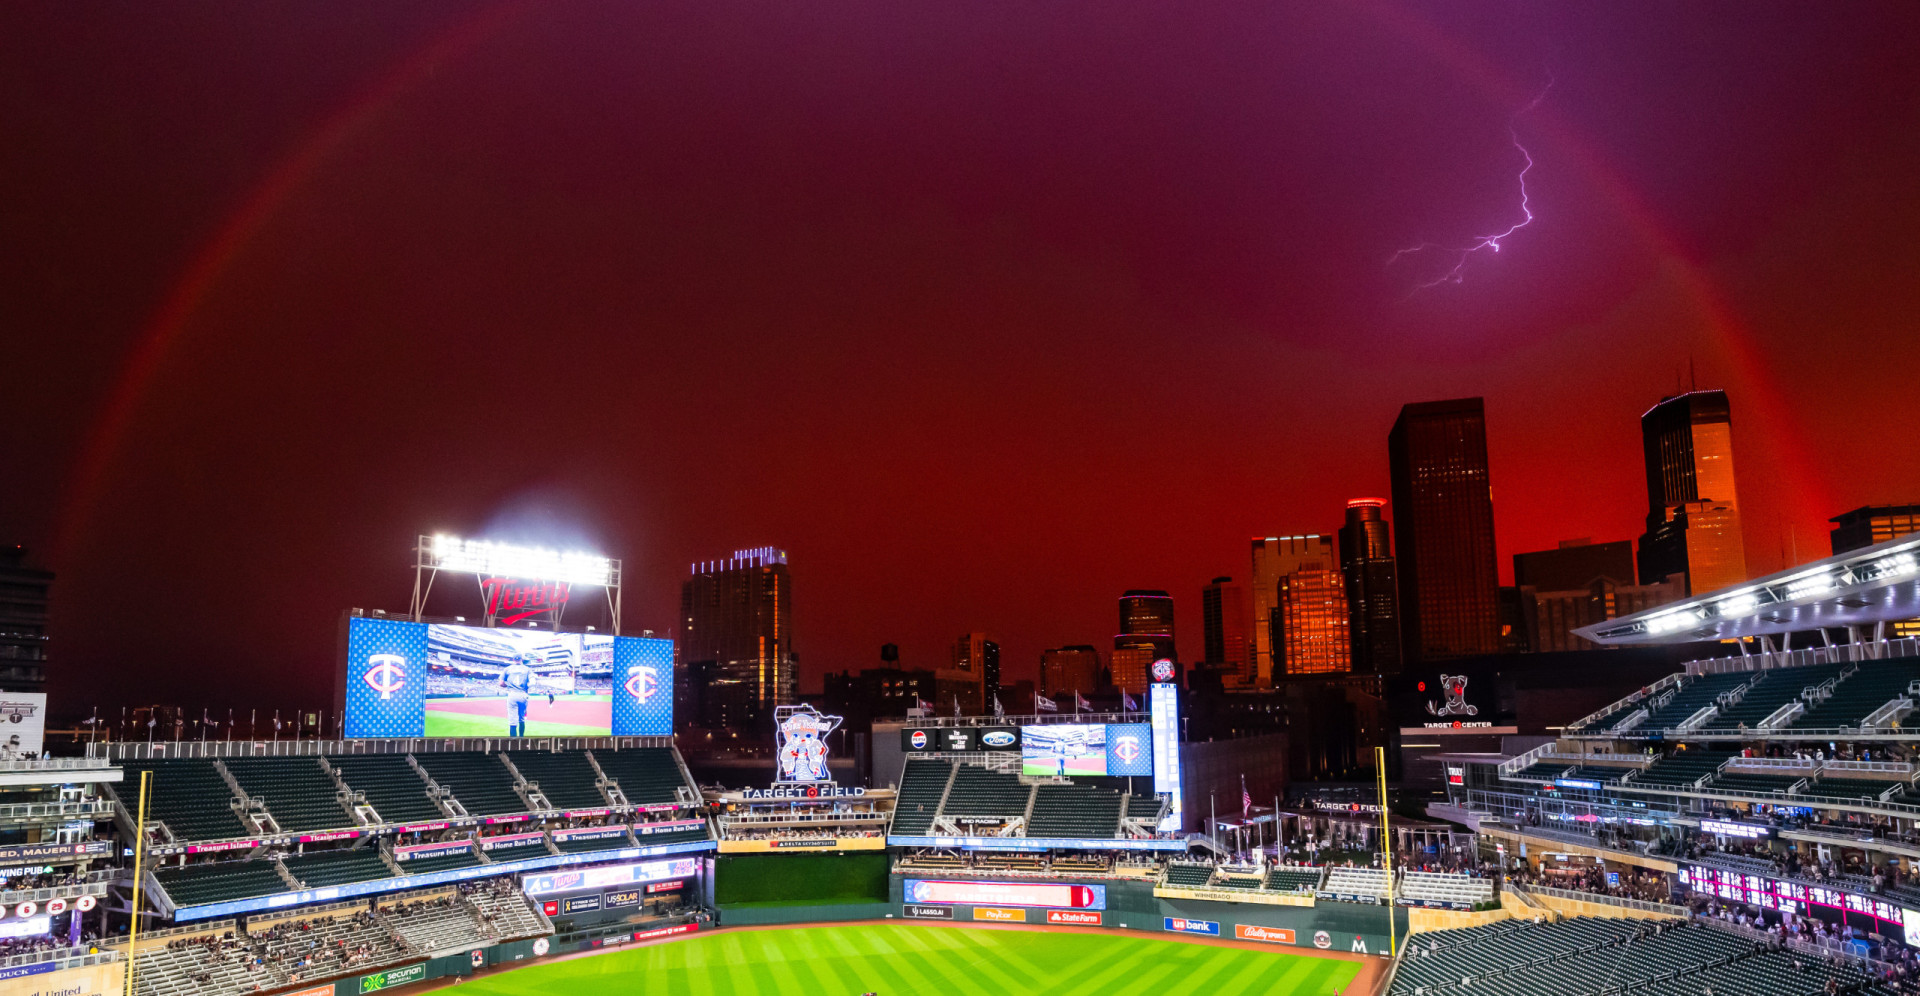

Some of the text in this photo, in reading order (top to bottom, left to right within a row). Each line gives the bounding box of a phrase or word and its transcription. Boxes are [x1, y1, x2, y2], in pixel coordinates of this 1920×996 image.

[482, 577, 569, 615] Twins
[988, 736, 1009, 744] Ford
[744, 787, 865, 798] TARGET FIELD
[23, 846, 71, 856] MAUER!
[196, 844, 229, 852] Treasure
[414, 851, 445, 859] Treasure
[24, 866, 43, 875] PUB
[552, 873, 580, 889] Twins
[986, 910, 1012, 920] Paycor
[1186, 920, 1210, 931] bank
[1244, 926, 1268, 940] Bally
[387, 966, 422, 980] securian
[387, 976, 412, 985] FINANCIAL
